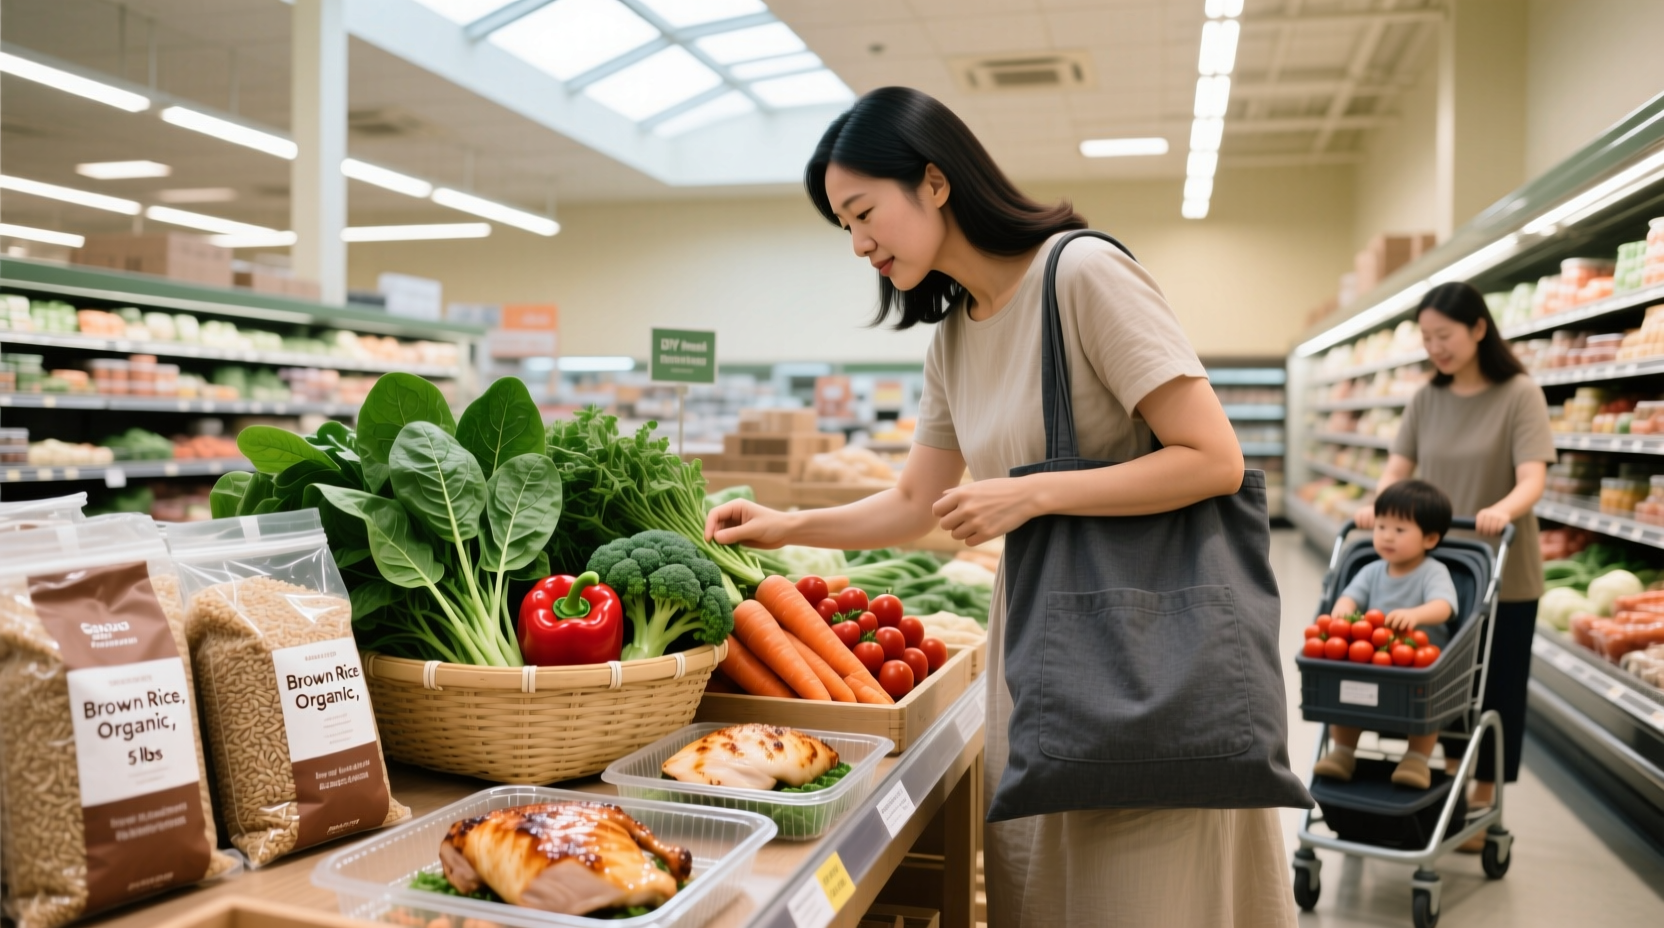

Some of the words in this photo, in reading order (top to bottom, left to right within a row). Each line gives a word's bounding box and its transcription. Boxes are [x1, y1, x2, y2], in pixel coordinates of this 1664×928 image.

[286, 671, 334, 691] Brown
[83, 696, 144, 719] Brown
[147, 688, 186, 708] Rice,
[97, 712, 176, 742] Organic,
[128, 750, 137, 766] 5
[139, 747, 163, 762] lbs
